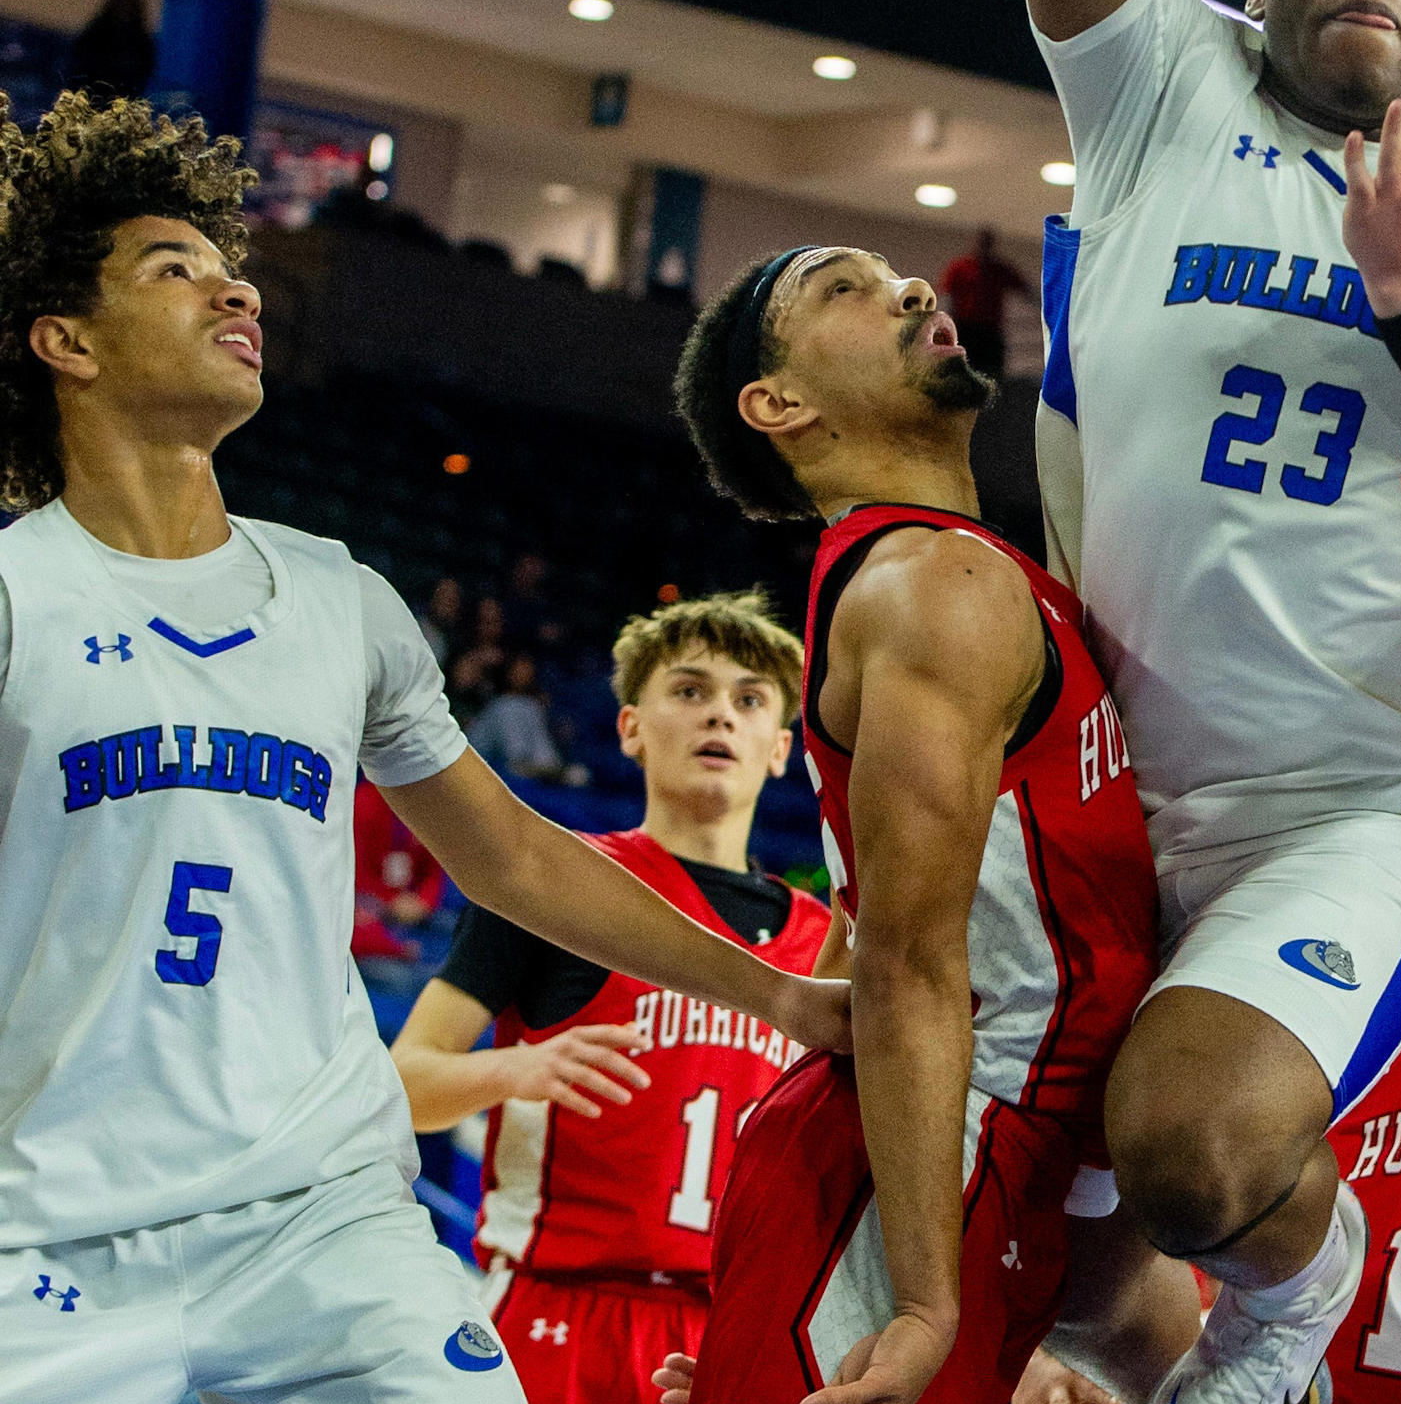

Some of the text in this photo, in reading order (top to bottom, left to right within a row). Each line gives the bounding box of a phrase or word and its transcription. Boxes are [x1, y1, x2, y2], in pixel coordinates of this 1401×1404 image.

[1200, 363, 1367, 506] 23
[58, 724, 332, 824] BULLDOGS
[155, 861, 233, 986] 5
[665, 1083, 758, 1234] 1
